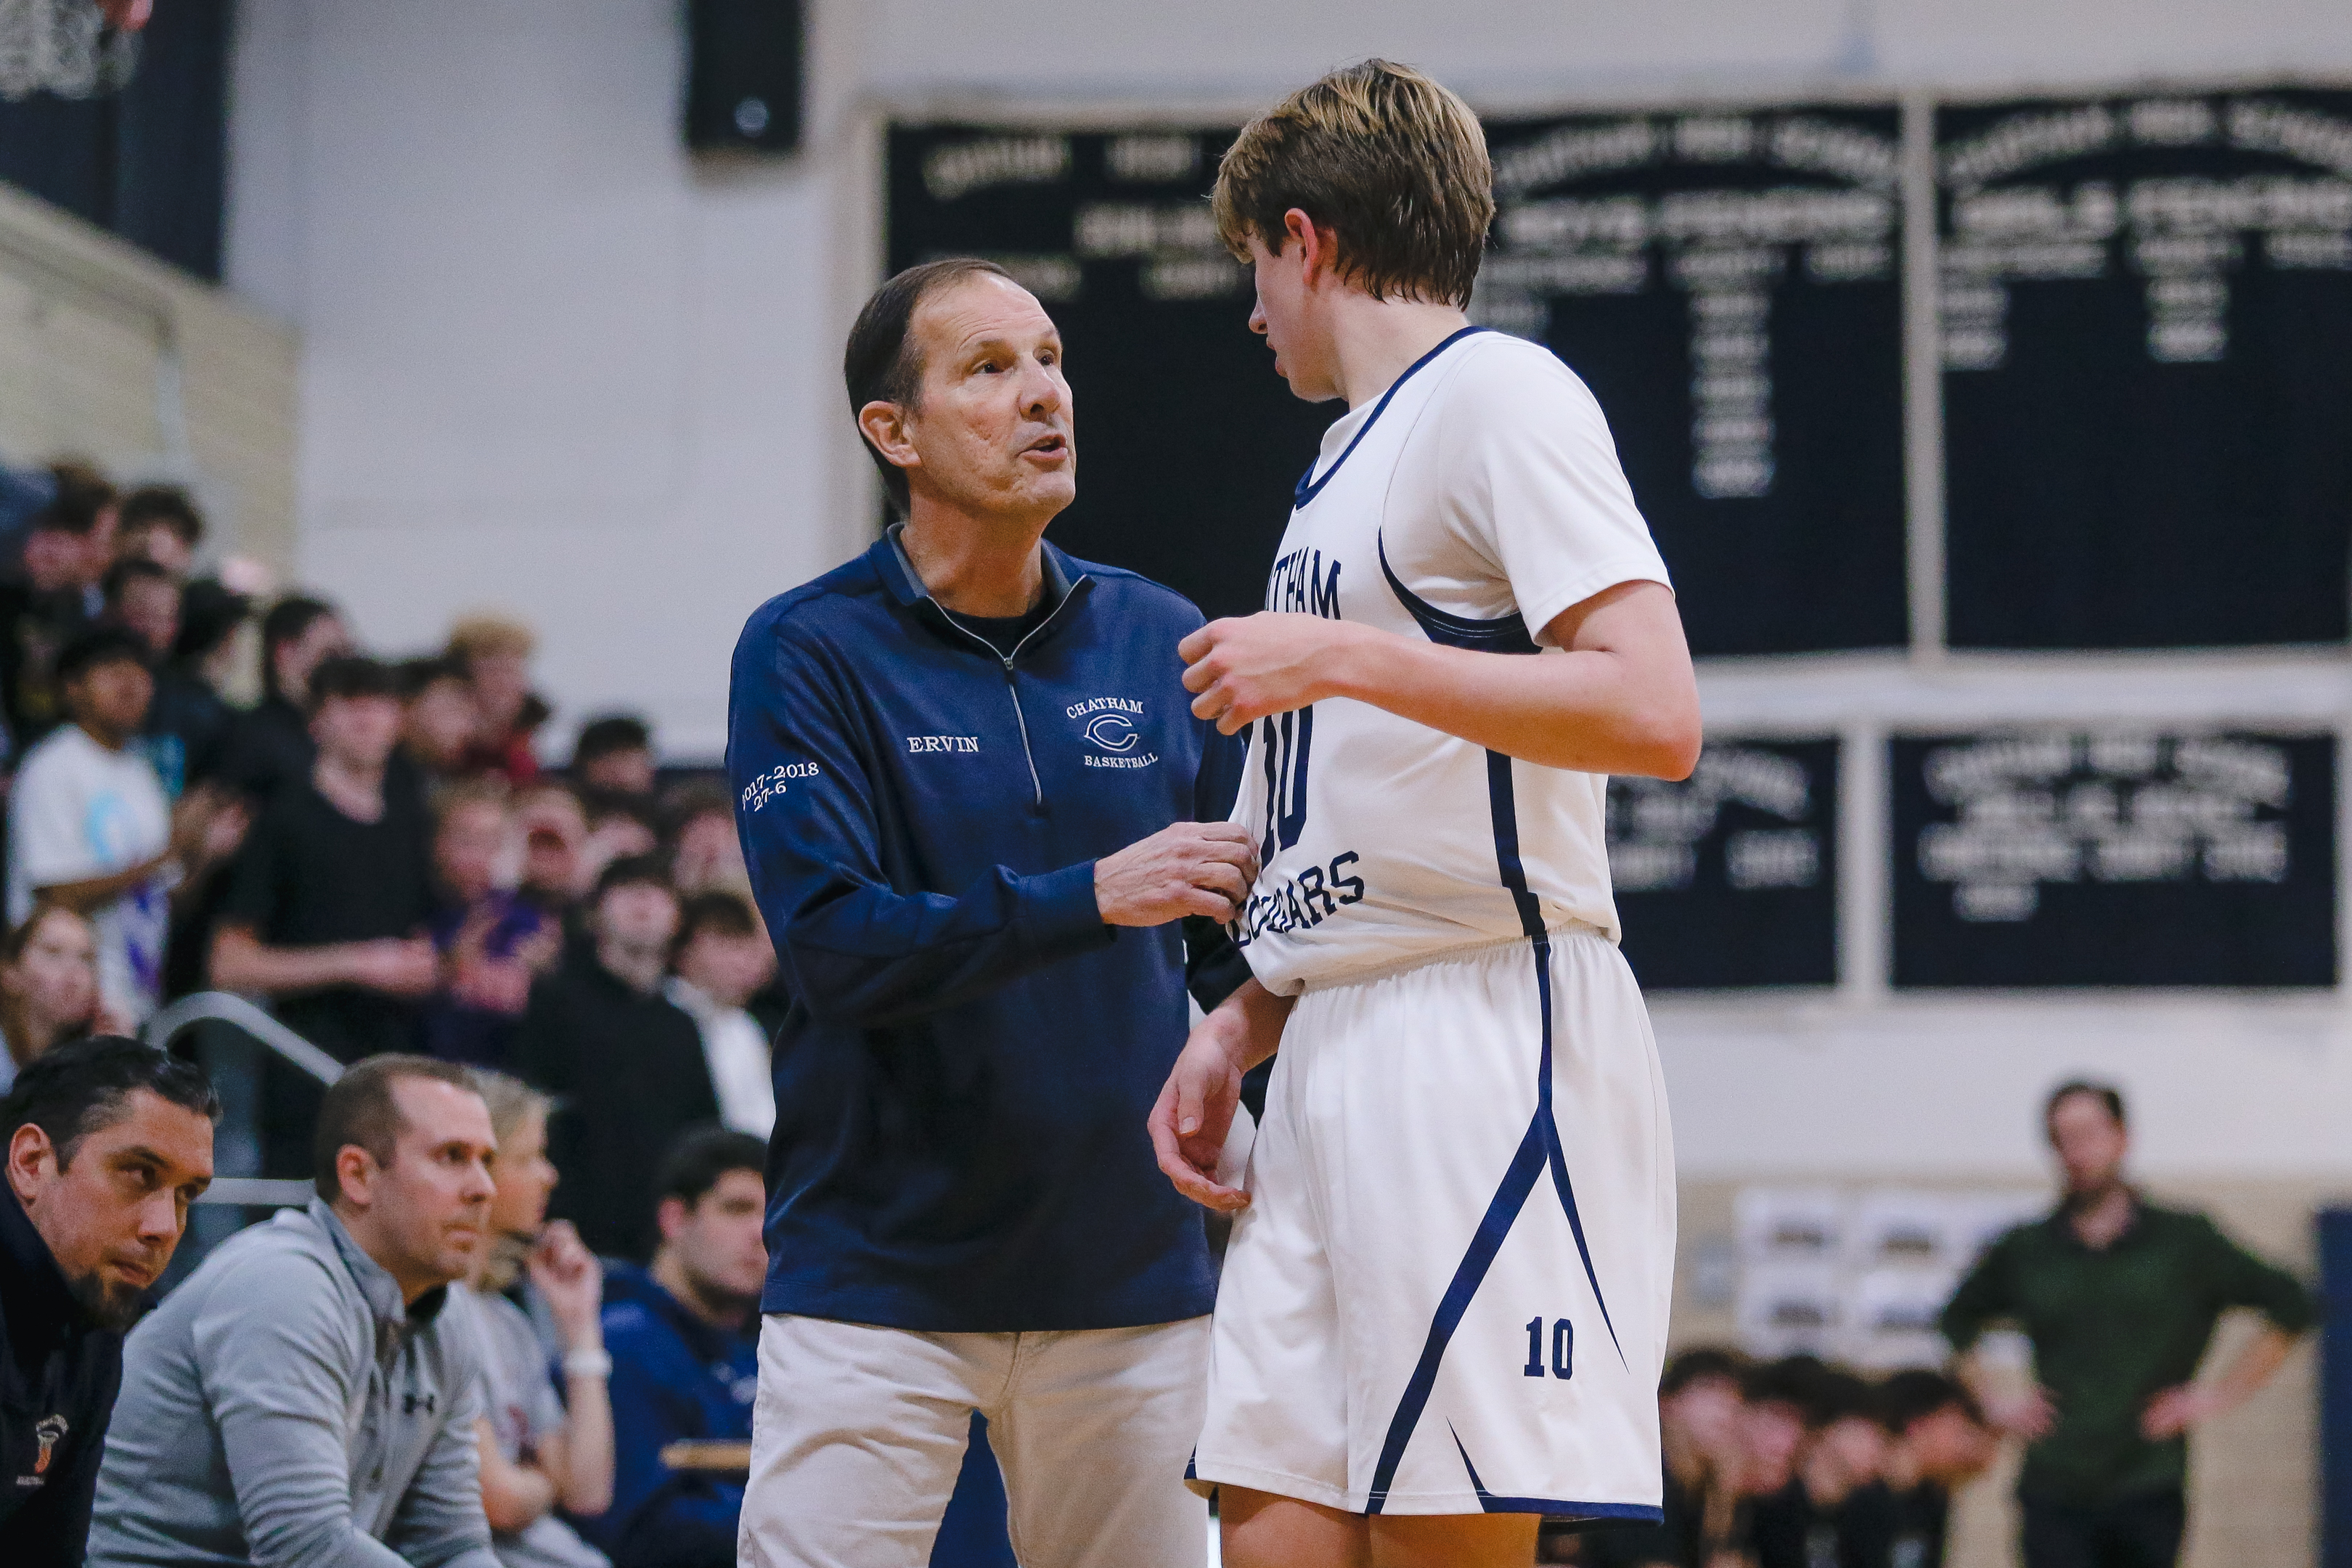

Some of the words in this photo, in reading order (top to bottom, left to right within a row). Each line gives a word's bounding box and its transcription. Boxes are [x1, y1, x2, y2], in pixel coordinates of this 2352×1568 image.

[1066, 697, 1144, 719] CHATHAM
[907, 735, 979, 752] ERVIN
[1084, 752, 1159, 769] BASKETBALL
[754, 780, 787, 812] 27-6
[1524, 1316, 1573, 1380] 10
